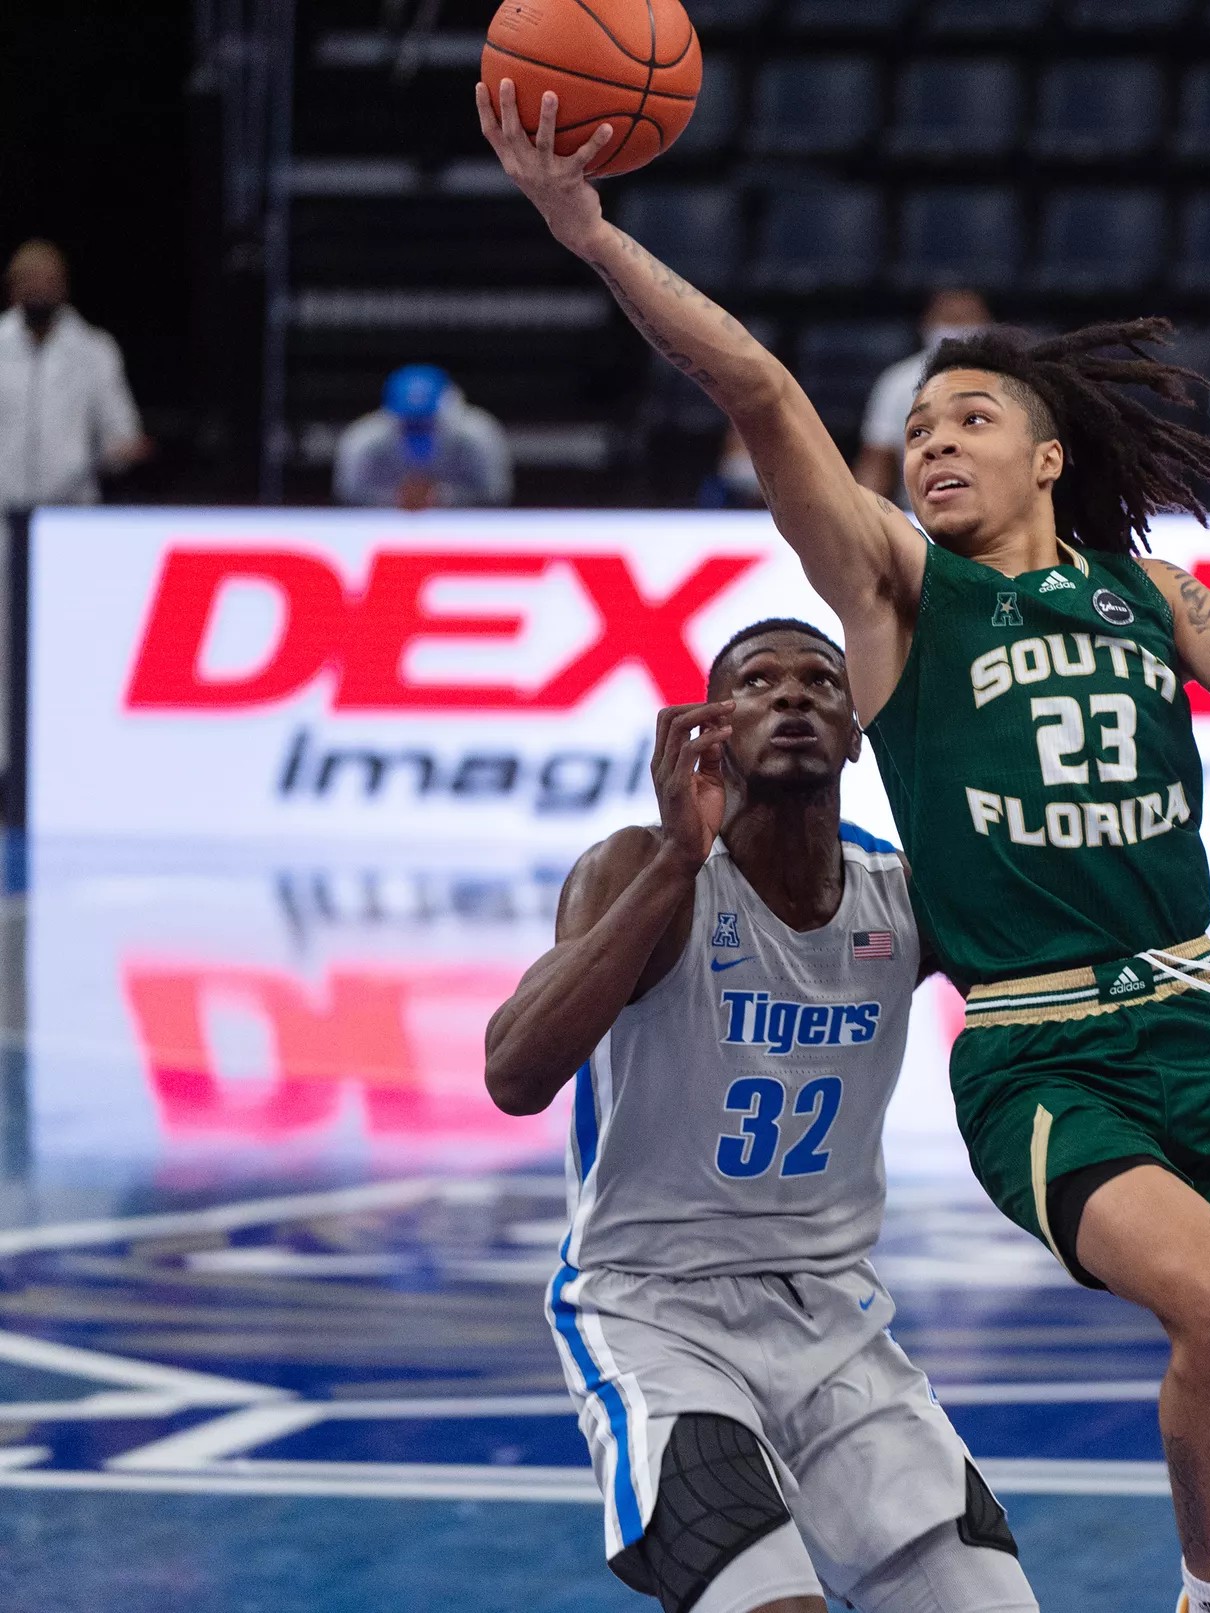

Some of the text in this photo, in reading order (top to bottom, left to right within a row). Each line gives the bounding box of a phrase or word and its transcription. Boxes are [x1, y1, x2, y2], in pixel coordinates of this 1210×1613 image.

[1038, 580, 1077, 595] adidas
[120, 545, 764, 711] DEX
[970, 632, 1177, 710] SOUTH
[281, 726, 650, 815] imagi
[1030, 692, 1138, 787] 23
[965, 781, 1191, 849] FLORIDA
[719, 989, 881, 1056] Tigers
[1109, 980, 1146, 995] adidas
[715, 1075, 844, 1180] 32
